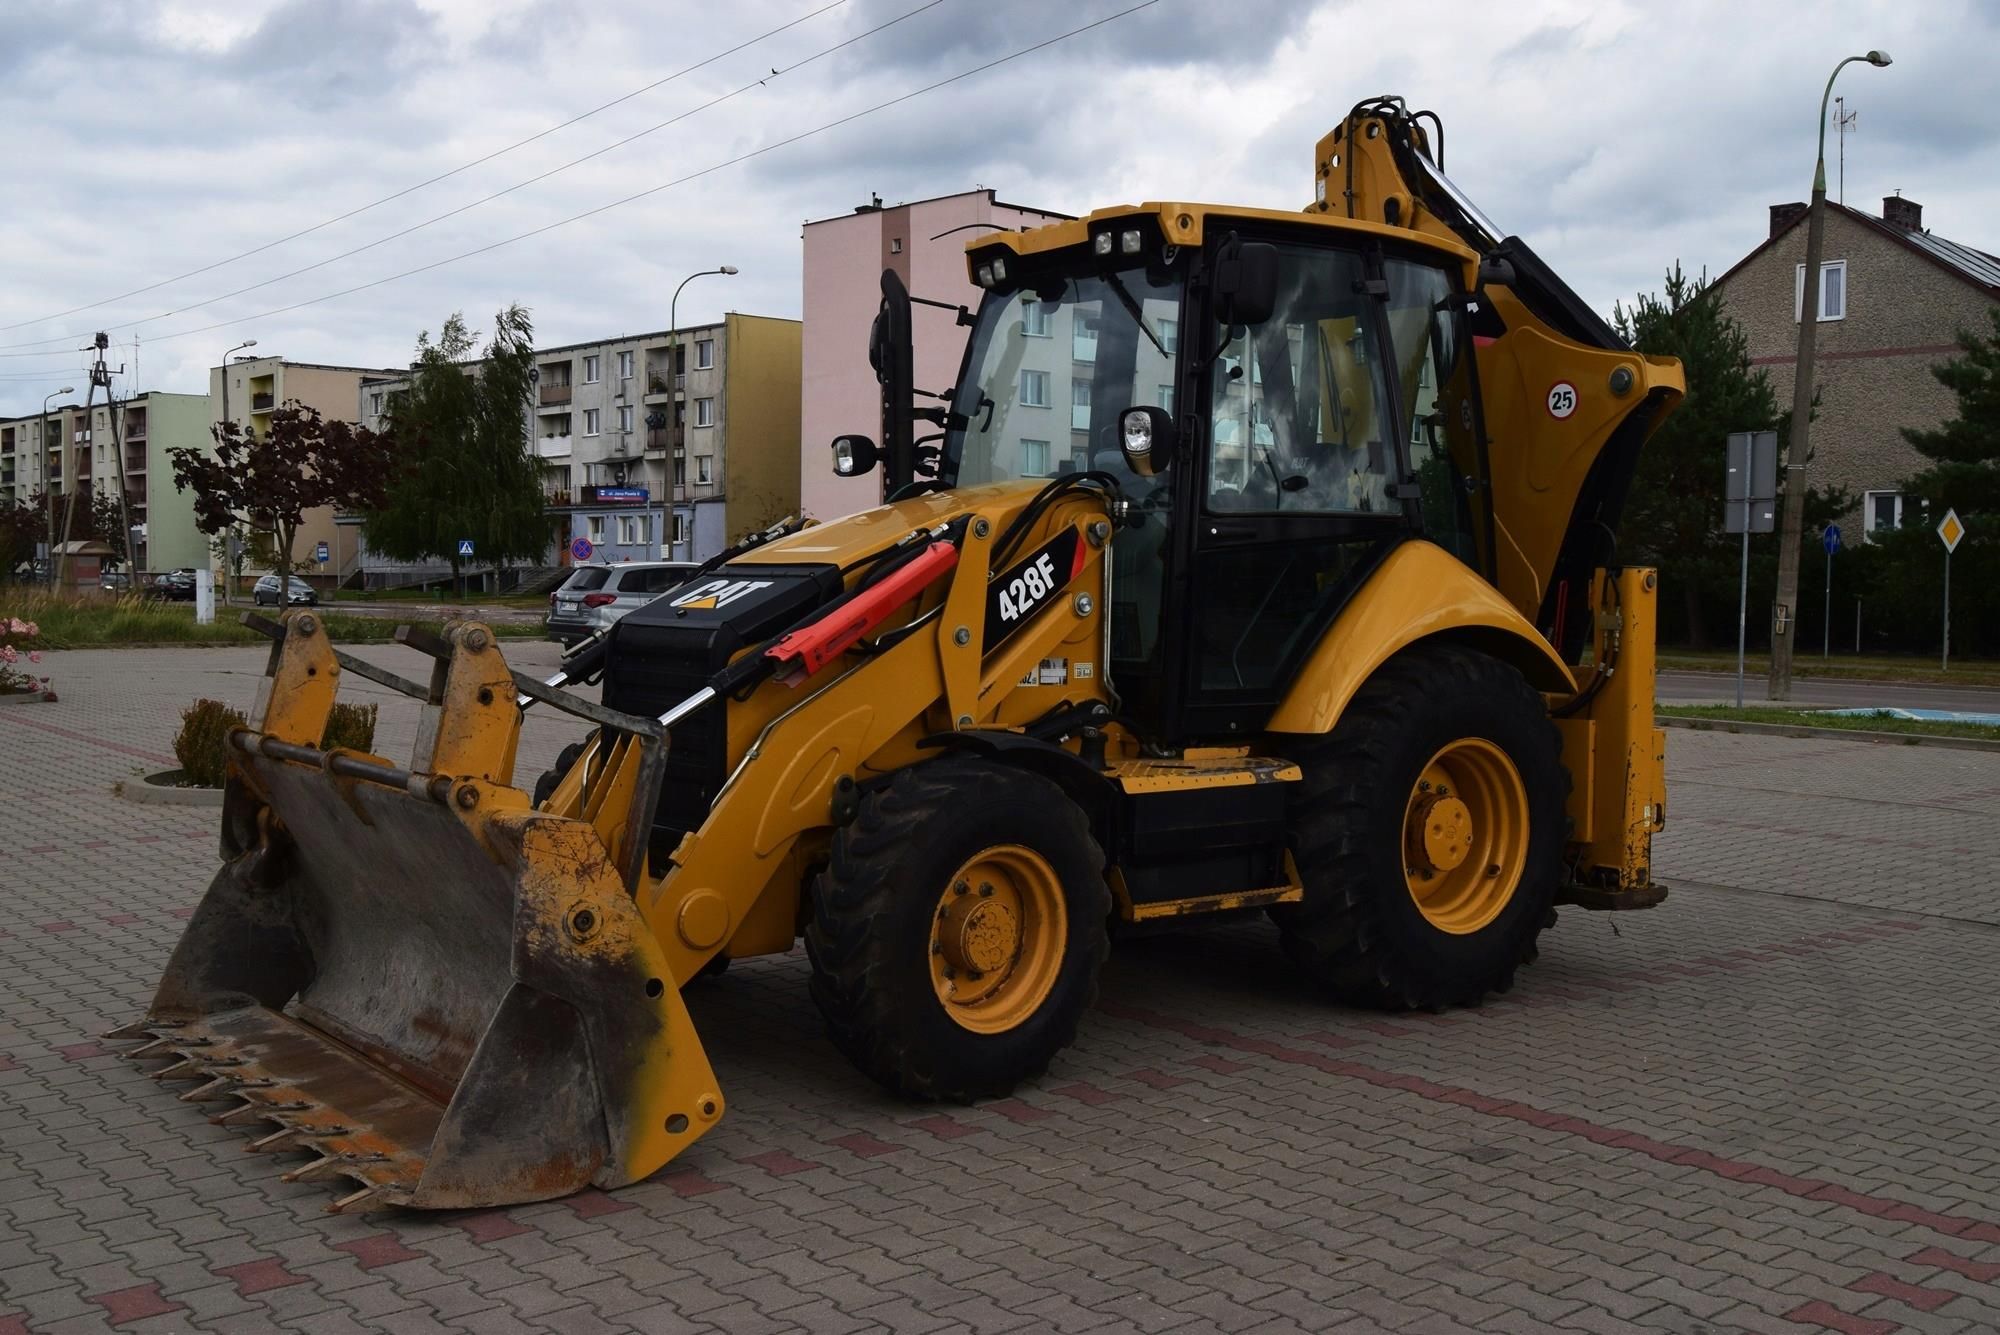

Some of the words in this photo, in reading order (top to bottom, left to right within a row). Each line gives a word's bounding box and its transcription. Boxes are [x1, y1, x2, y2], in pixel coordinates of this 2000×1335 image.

[1552, 391, 1572, 410] 25
[669, 579, 775, 609] CAT
[998, 552, 1055, 622] 428F
